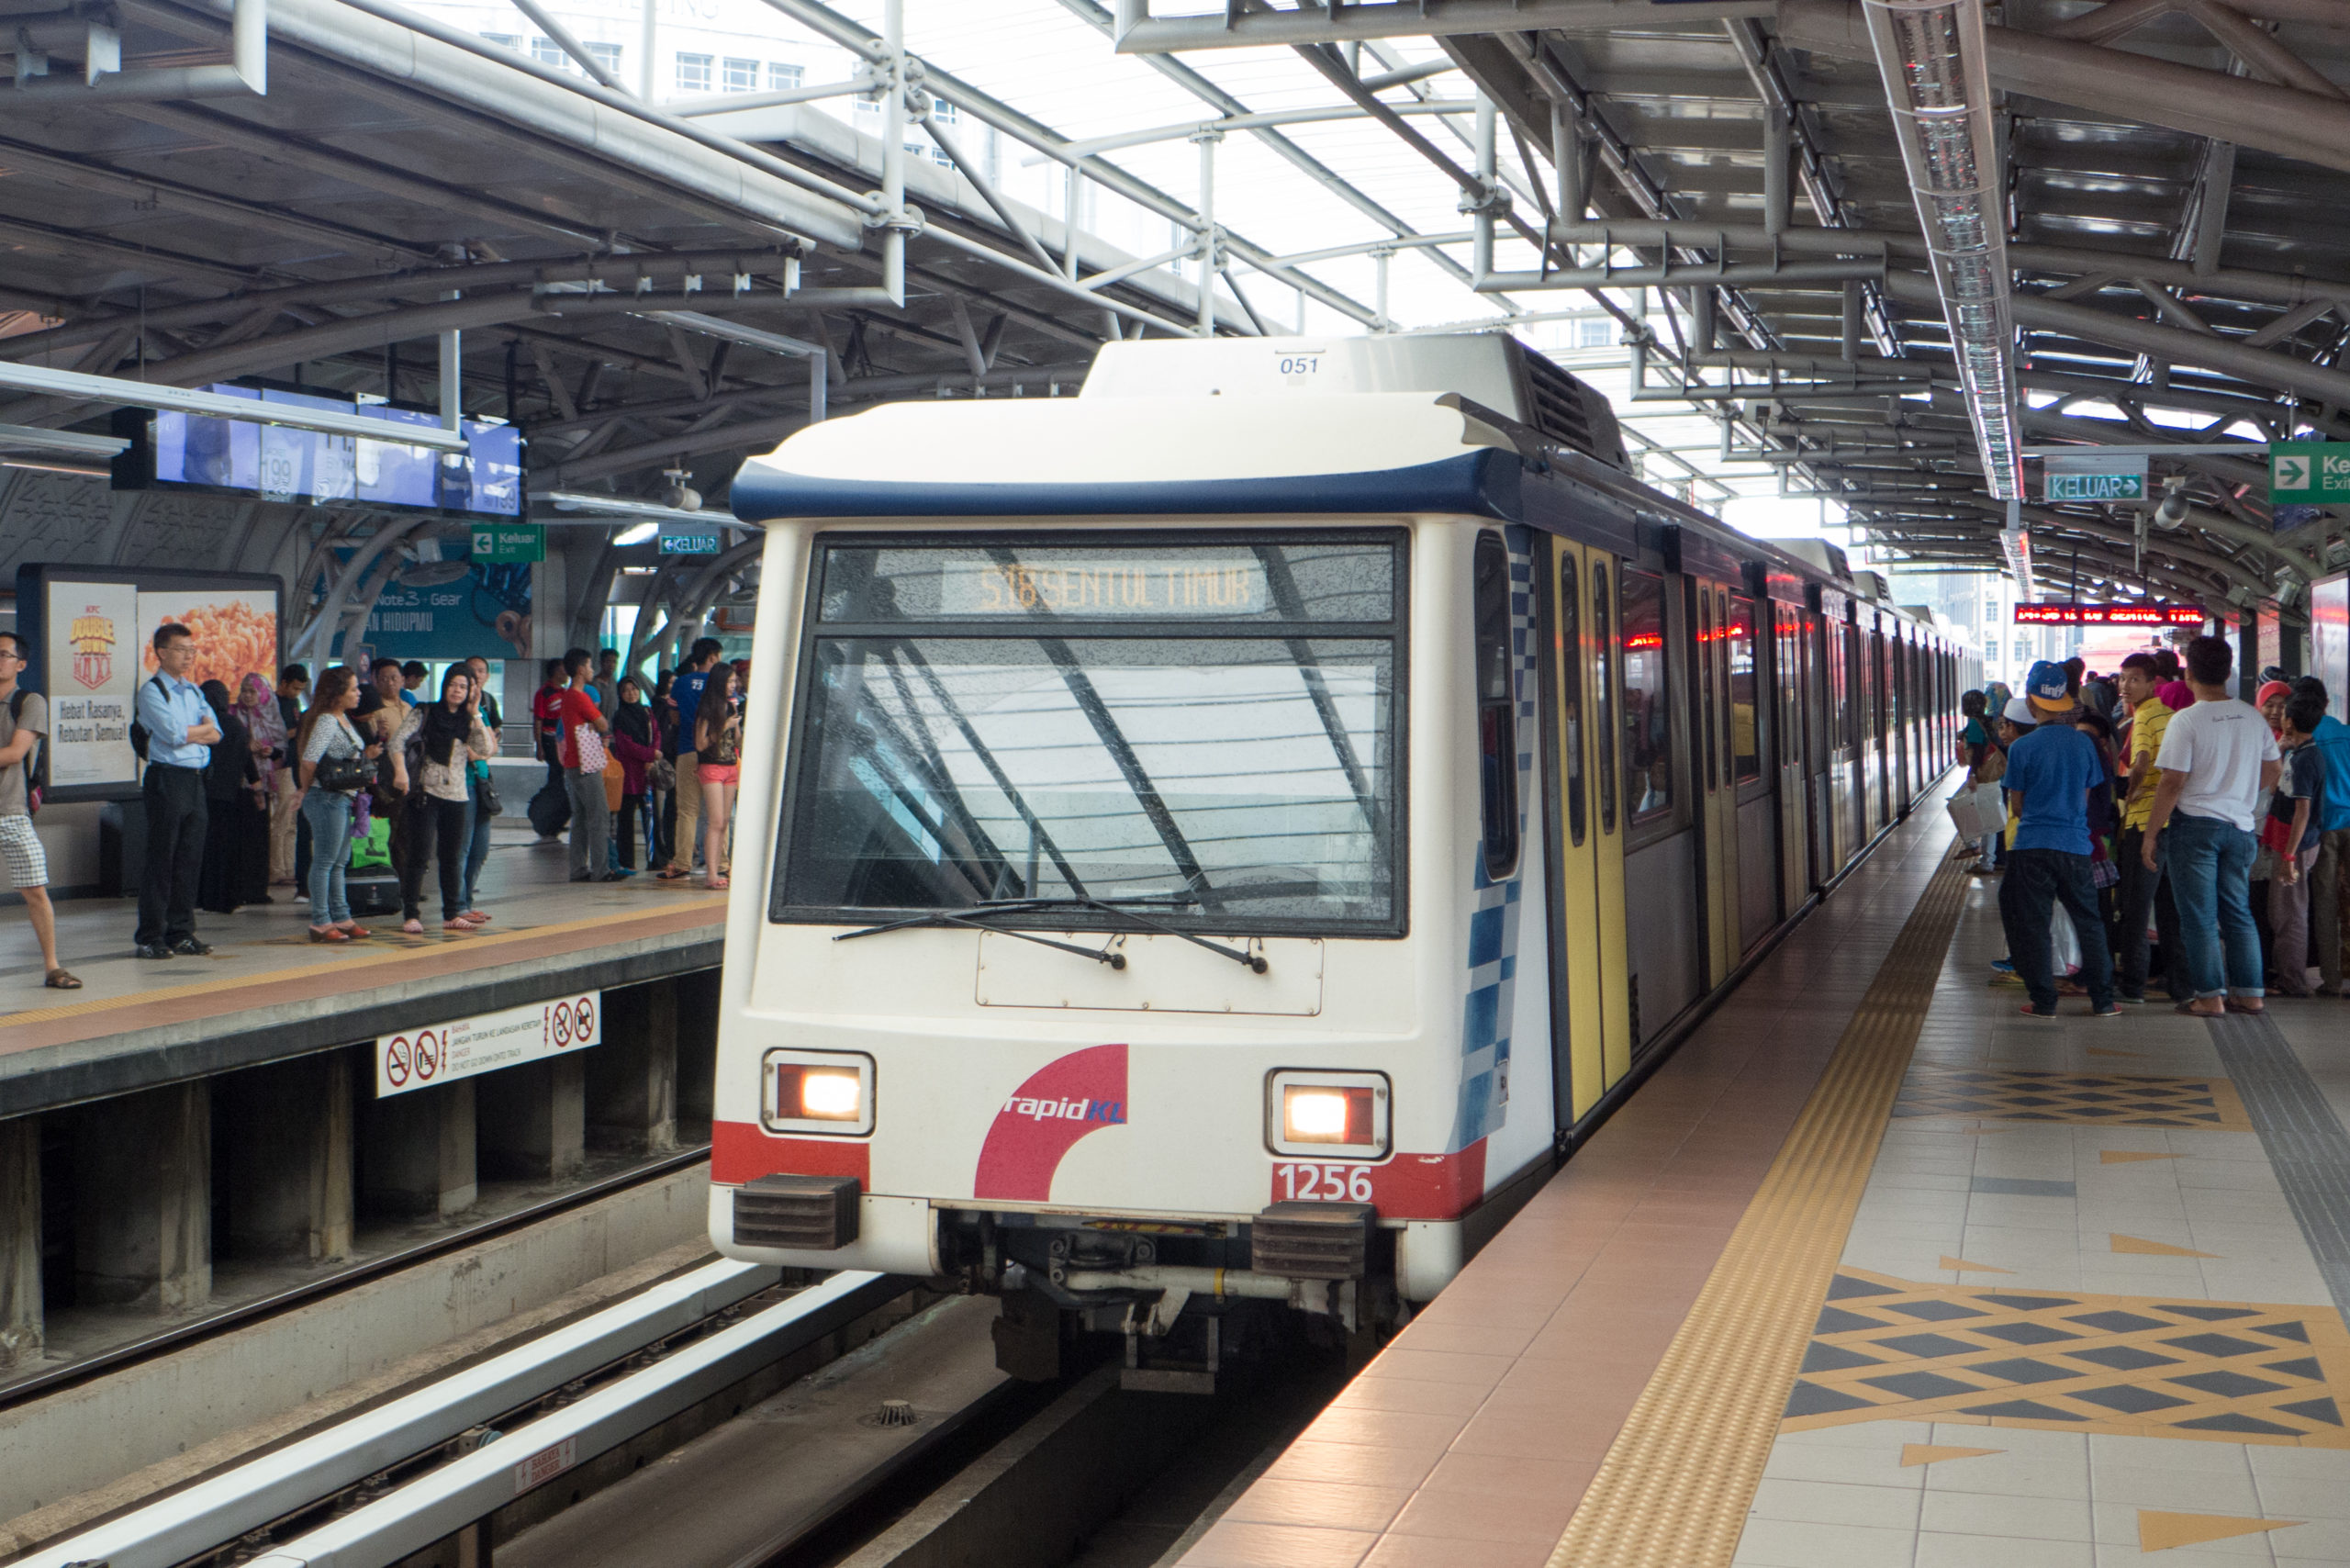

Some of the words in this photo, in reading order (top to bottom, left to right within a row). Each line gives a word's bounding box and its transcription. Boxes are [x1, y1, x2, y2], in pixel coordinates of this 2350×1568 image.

[1280, 357, 1318, 375] 051
[2053, 477, 2122, 498] KELUAR
[498, 532, 536, 544] Keluar
[673, 536, 716, 552] KELUAR
[498, 545, 516, 554] Exit
[1042, 566, 1154, 608] SENTUL
[1159, 566, 1250, 607] TIMUR
[85, 605, 101, 614] KFC
[431, 593, 463, 606] Gear
[70, 616, 115, 644] DOUBLE
[383, 612, 433, 632] HIDUPMU
[691, 681, 704, 690] 73
[60, 700, 85, 721] Hebat
[87, 700, 125, 722] Rasanya,
[58, 723, 94, 744] Rebutan
[95, 722, 127, 742] Semua!
[452, 1035, 471, 1047] JANGAN
[452, 1047, 471, 1059] DANGER
[1003, 1097, 1126, 1124] rapidKL
[1278, 1164, 1373, 1203] 1256
[532, 1447, 560, 1471] BAHAYA
[532, 1459, 560, 1483] DANGER
